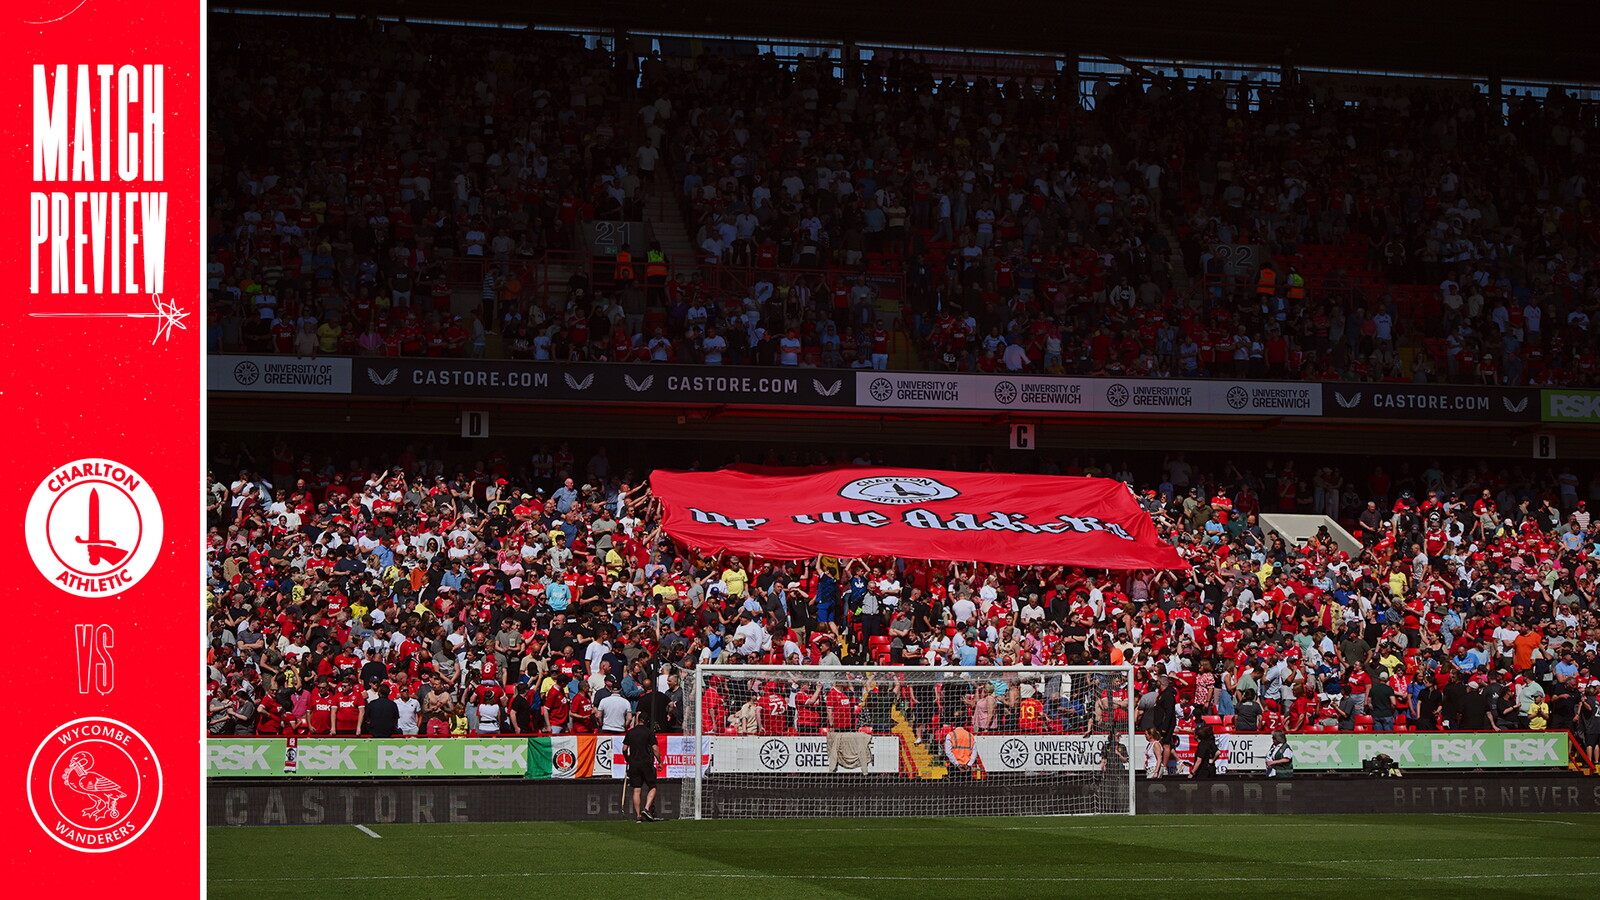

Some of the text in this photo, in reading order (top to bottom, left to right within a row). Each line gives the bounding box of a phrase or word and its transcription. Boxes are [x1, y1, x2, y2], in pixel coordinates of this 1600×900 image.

[595, 221, 630, 245] 21
[264, 364, 332, 377] UNIVERSITY OF
[264, 374, 332, 386] GREENWICH
[413, 369, 548, 388] CASTORE.COM
[667, 376, 798, 394] CASTORE.COM
[897, 380, 958, 390] UNIVERSITY OF
[896, 389, 959, 401] GREENWICH
[1020, 383, 1081, 393] UNIVERSITY OF
[1133, 385, 1192, 396] UNIVERSITY OF
[1252, 388, 1310, 398] UNIVERSITY OF
[1020, 392, 1082, 404] GREENWICH
[1132, 395, 1192, 406] GREENWICH
[1252, 397, 1311, 409] GREENWICH
[1373, 394, 1490, 410] CASTORE.COM
[1550, 394, 1600, 418] RSK
[469, 413, 482, 436] D
[1016, 427, 1030, 449] C
[1540, 436, 1550, 458] B
[769, 701, 786, 716] 23
[1021, 706, 1035, 719] 19
[1269, 719, 1276, 729] 2
[1034, 741, 1094, 753] UNIVERSITY
[1239, 740, 1253, 750] OF
[1430, 739, 1488, 763] RSK
[1503, 738, 1560, 761] RSK
[377, 745, 444, 771] RSK
[463, 744, 528, 770] RSK
[1034, 752, 1102, 766] GREENWIC
[1393, 786, 1487, 808] BETTER
[1500, 786, 1580, 808] NEVER
[225, 788, 470, 825] CASTORE
